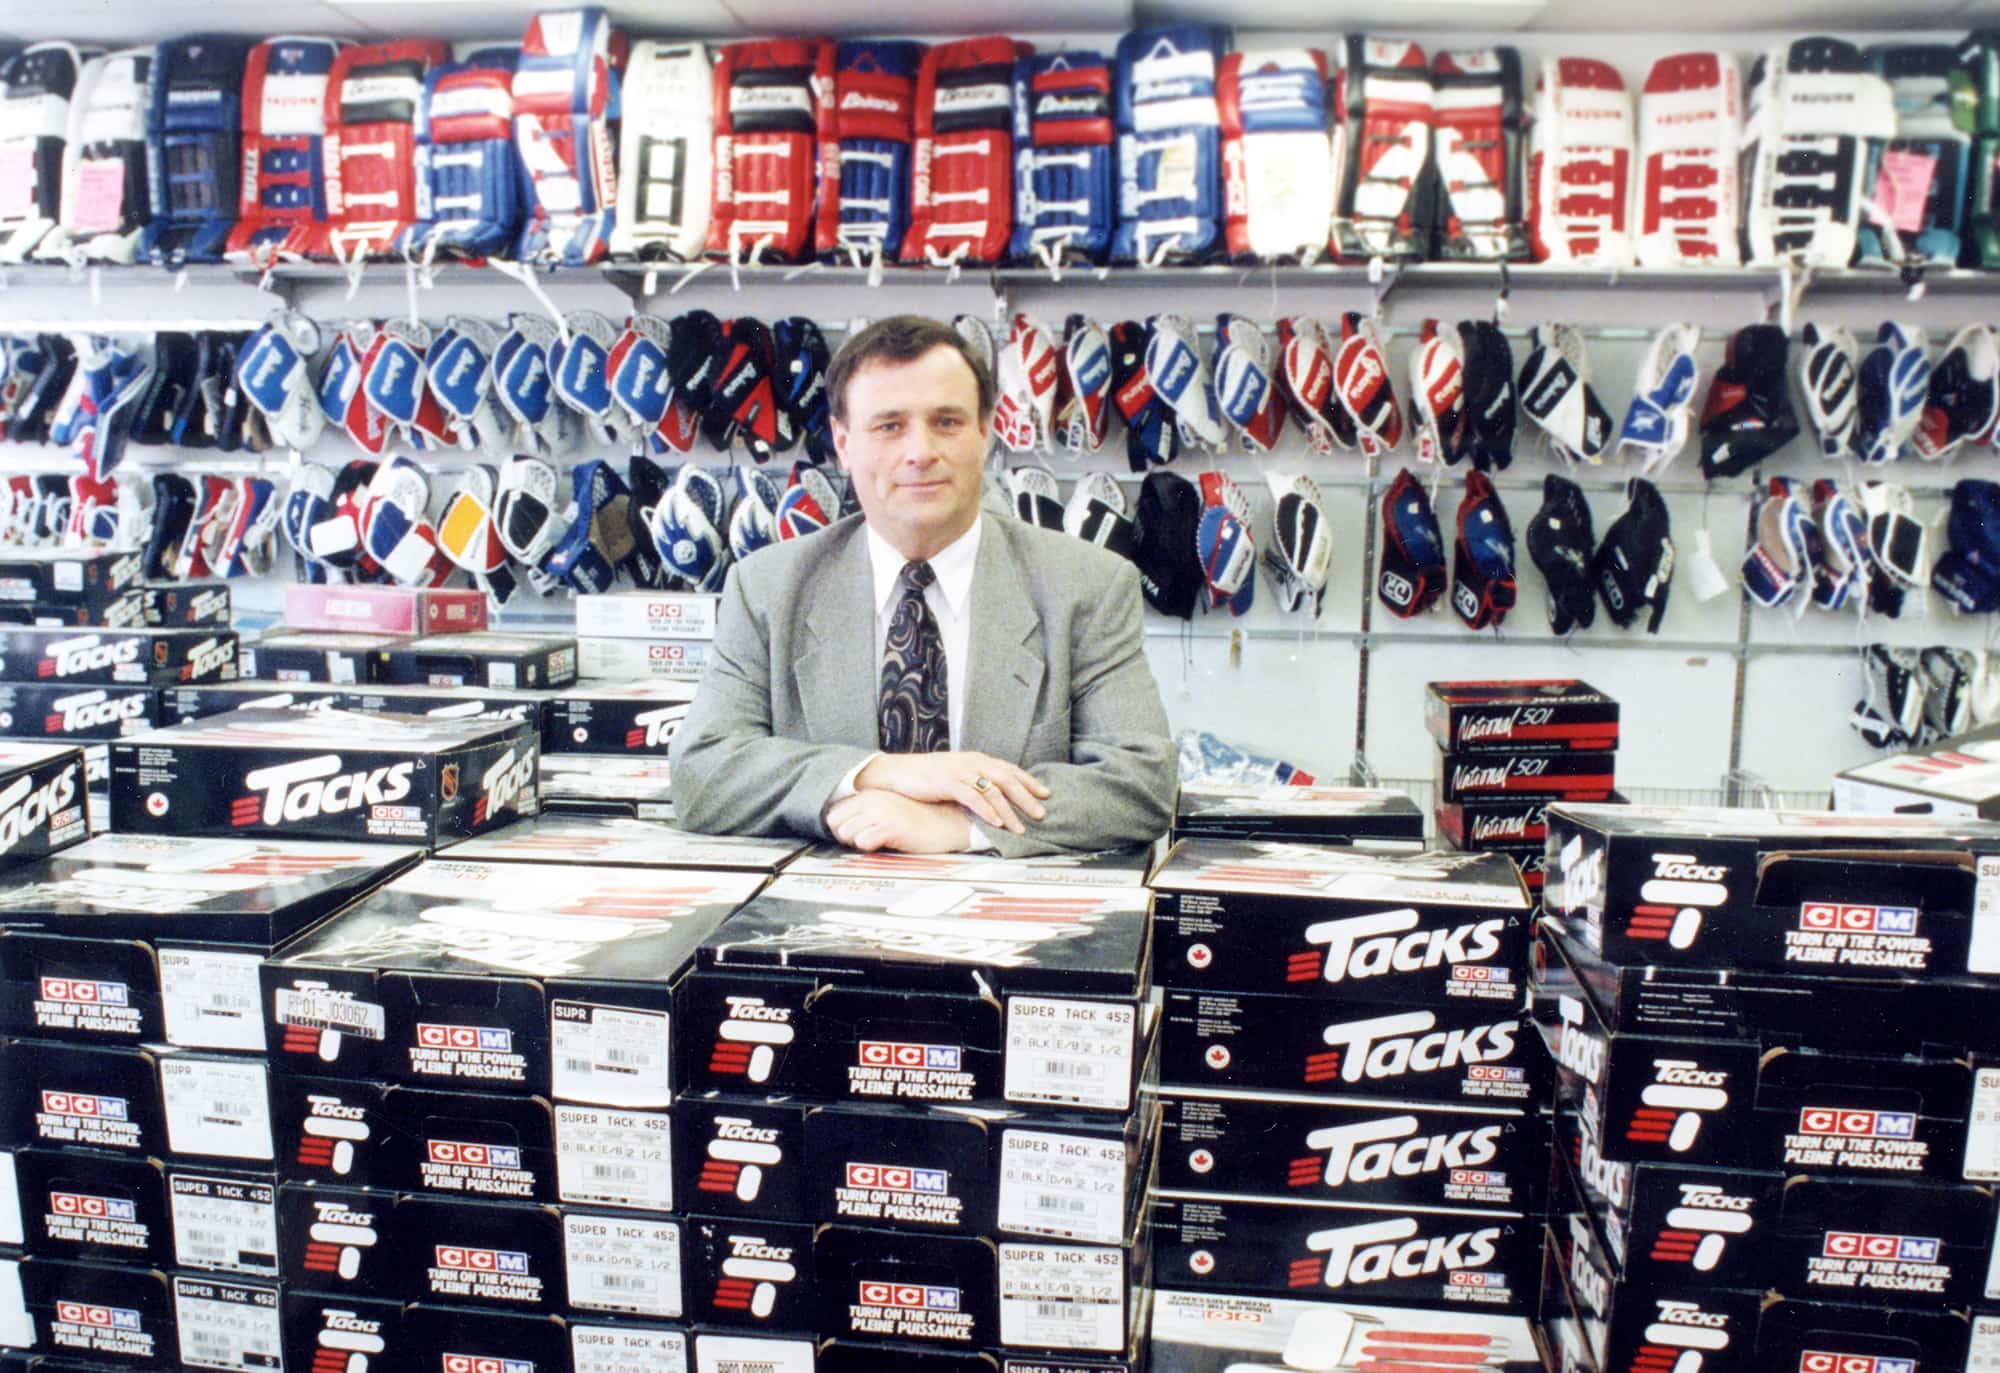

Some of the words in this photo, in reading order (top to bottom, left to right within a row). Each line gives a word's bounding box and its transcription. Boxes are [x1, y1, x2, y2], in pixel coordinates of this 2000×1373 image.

[1458, 707, 1521, 740] National
[1518, 708, 1554, 725] 501
[1452, 758, 1515, 790] National
[1513, 759, 1549, 776] 501
[247, 755, 415, 827] Tacks
[1471, 807, 1533, 841] National
[1801, 905, 1915, 933] CCM
[1305, 909, 1504, 983] Tacks
[1784, 932, 1823, 946] TURN
[1824, 934, 1848, 947] ON
[1848, 935, 1875, 949] THE
[1876, 937, 1932, 952] POWER.
[1785, 946, 1836, 963] PLEINE
[1839, 949, 1927, 968] PUISSANCE.
[43, 979, 126, 1004] CCM
[34, 1001, 62, 1013] TURN
[63, 1003, 80, 1015] ON
[80, 1005, 100, 1016] THE
[101, 1006, 142, 1020] POWER.
[555, 1006, 588, 1020] SUPR
[1014, 1004, 1056, 1017] SUPER
[1065, 1008, 1097, 1021] TACK
[1106, 1012, 1131, 1023] 452
[37, 1013, 74, 1028] PLEINE
[76, 1016, 141, 1033] PUISSANCE.
[419, 1025, 510, 1051] CCM
[1323, 1010, 1520, 1082] Tacks
[409, 1048, 440, 1060] TURN
[441, 1050, 459, 1062] ON
[460, 1051, 481, 1063] THE
[482, 1053, 527, 1066] POWER.
[861, 1043, 958, 1069] CCM
[412, 1060, 453, 1075] PLEINE
[455, 1063, 525, 1080] PUISSANCE.
[848, 1067, 881, 1080] TURN
[883, 1069, 902, 1081] ON
[903, 1070, 926, 1083] THE
[928, 1072, 975, 1086] POWER.
[851, 1080, 894, 1095] PLEINE
[897, 1083, 972, 1100] PUISSANCE.
[44, 1092, 126, 1119] CCM
[560, 1112, 598, 1125] SUPER
[608, 1115, 636, 1128] TACK
[644, 1119, 667, 1131] 452
[1801, 1109, 1914, 1137] CCM
[430, 1142, 519, 1168] CCM
[1007, 1138, 1049, 1153] SUPER
[1059, 1144, 1091, 1157] TACK
[1099, 1147, 1125, 1161] 452
[1306, 1115, 1502, 1187] Tacks
[1783, 1135, 1822, 1149] TURN
[1823, 1137, 1846, 1150] ON
[1846, 1139, 1873, 1152] THE
[1874, 1140, 1929, 1155] POWER.
[1784, 1149, 1835, 1165] PLEINE
[1837, 1152, 1924, 1170] PUISSANCE.
[420, 1163, 451, 1175] TURN
[451, 1166, 469, 1177] ON
[470, 1167, 491, 1179] THE
[492, 1169, 535, 1183] POWER.
[849, 1165, 945, 1193] CCM
[174, 1181, 210, 1195] SUPER
[217, 1186, 244, 1198] TACK
[250, 1190, 272, 1201] 452
[423, 1175, 463, 1189] PLEINE
[465, 1178, 534, 1195] PUISSANCE.
[53, 1194, 134, 1220] CCM
[835, 1188, 868, 1202] TURN
[870, 1191, 889, 1204] ON
[891, 1193, 913, 1206] THE
[915, 1195, 962, 1210] POWER.
[838, 1201, 881, 1217] PLEINE
[884, 1205, 959, 1224] PUISSANCE.
[569, 1224, 607, 1236] SUPER
[617, 1227, 644, 1239] TACK
[653, 1230, 676, 1242] 452
[1004, 1250, 1046, 1262] SUPER
[1054, 1252, 1087, 1264] TACK
[1094, 1254, 1119, 1265] 452
[1306, 1217, 1501, 1288] Tacks
[1824, 1234, 1938, 1261] CCM
[438, 1247, 526, 1273] CCM
[1807, 1257, 1846, 1271] TURN
[1846, 1260, 1869, 1272] ON
[1869, 1262, 1896, 1274] THE
[1897, 1263, 1952, 1278] POWER.
[427, 1268, 458, 1281] TURN
[459, 1271, 477, 1283] ON
[477, 1273, 498, 1284] THE
[499, 1275, 543, 1289] POWER.
[1807, 1270, 1858, 1286] PLEINE
[1859, 1274, 1947, 1292] PUISSANCE.
[178, 1284, 214, 1298] SUPER
[221, 1289, 248, 1302] TACK
[254, 1294, 275, 1305] 452
[431, 1280, 470, 1295] PLEINE
[472, 1284, 541, 1301] PUISSANCE.
[862, 1283, 957, 1310] CCM
[59, 1303, 139, 1330] CCM
[849, 1305, 881, 1318] TURN
[883, 1308, 902, 1320] ON
[903, 1310, 926, 1322] THE
[927, 1312, 974, 1326] POWER.
[852, 1318, 894, 1333] PLEINE
[897, 1321, 972, 1339] PUISSANCE.
[578, 1334, 614, 1346] SUPER
[624, 1337, 652, 1348] TACK
[660, 1340, 682, 1351] 452
[444, 1354, 533, 1373] CCM
[1802, 1351, 1915, 1373] CCM
